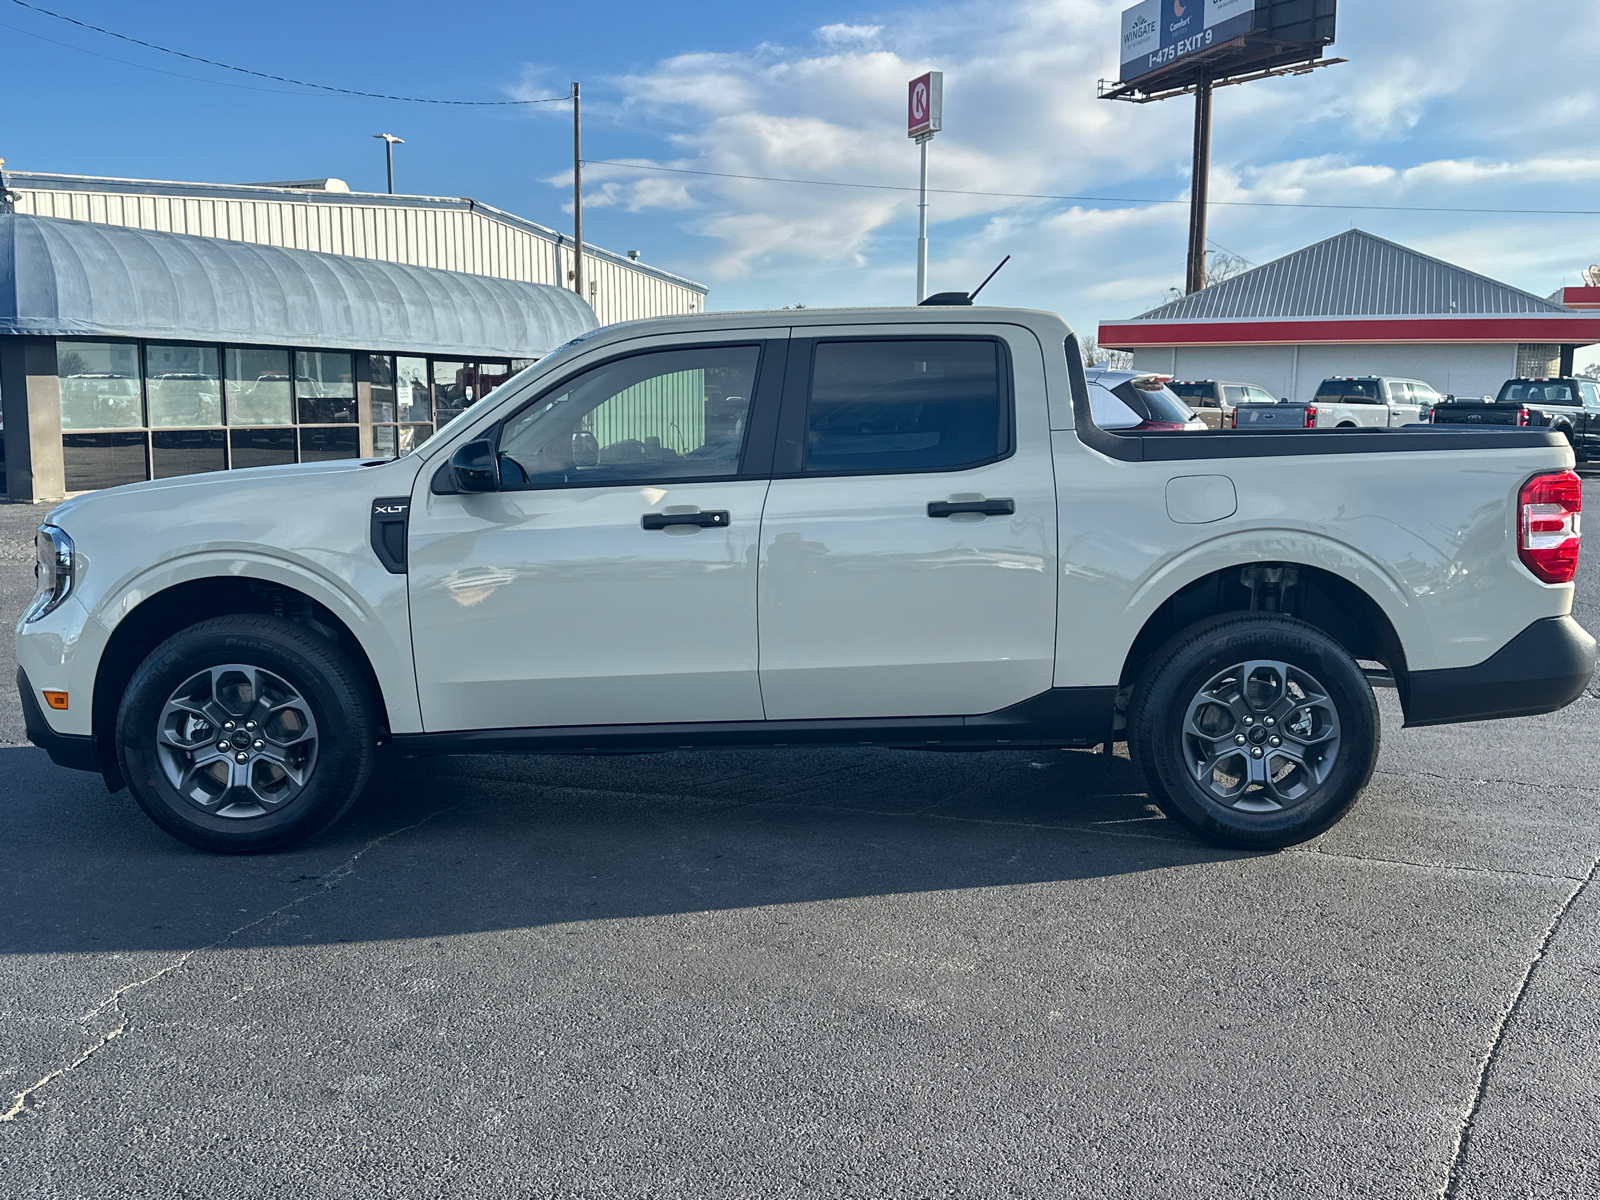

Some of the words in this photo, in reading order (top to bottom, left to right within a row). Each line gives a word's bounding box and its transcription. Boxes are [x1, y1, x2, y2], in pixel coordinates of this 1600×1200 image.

[1123, 21, 1156, 44] WINGATE
[1169, 17, 1190, 32] Comfort
[1149, 45, 1175, 67] I-475
[1177, 32, 1203, 56] EXIT
[1205, 29, 1213, 44] 9
[914, 86, 926, 115] K
[374, 505, 408, 514] XLT
